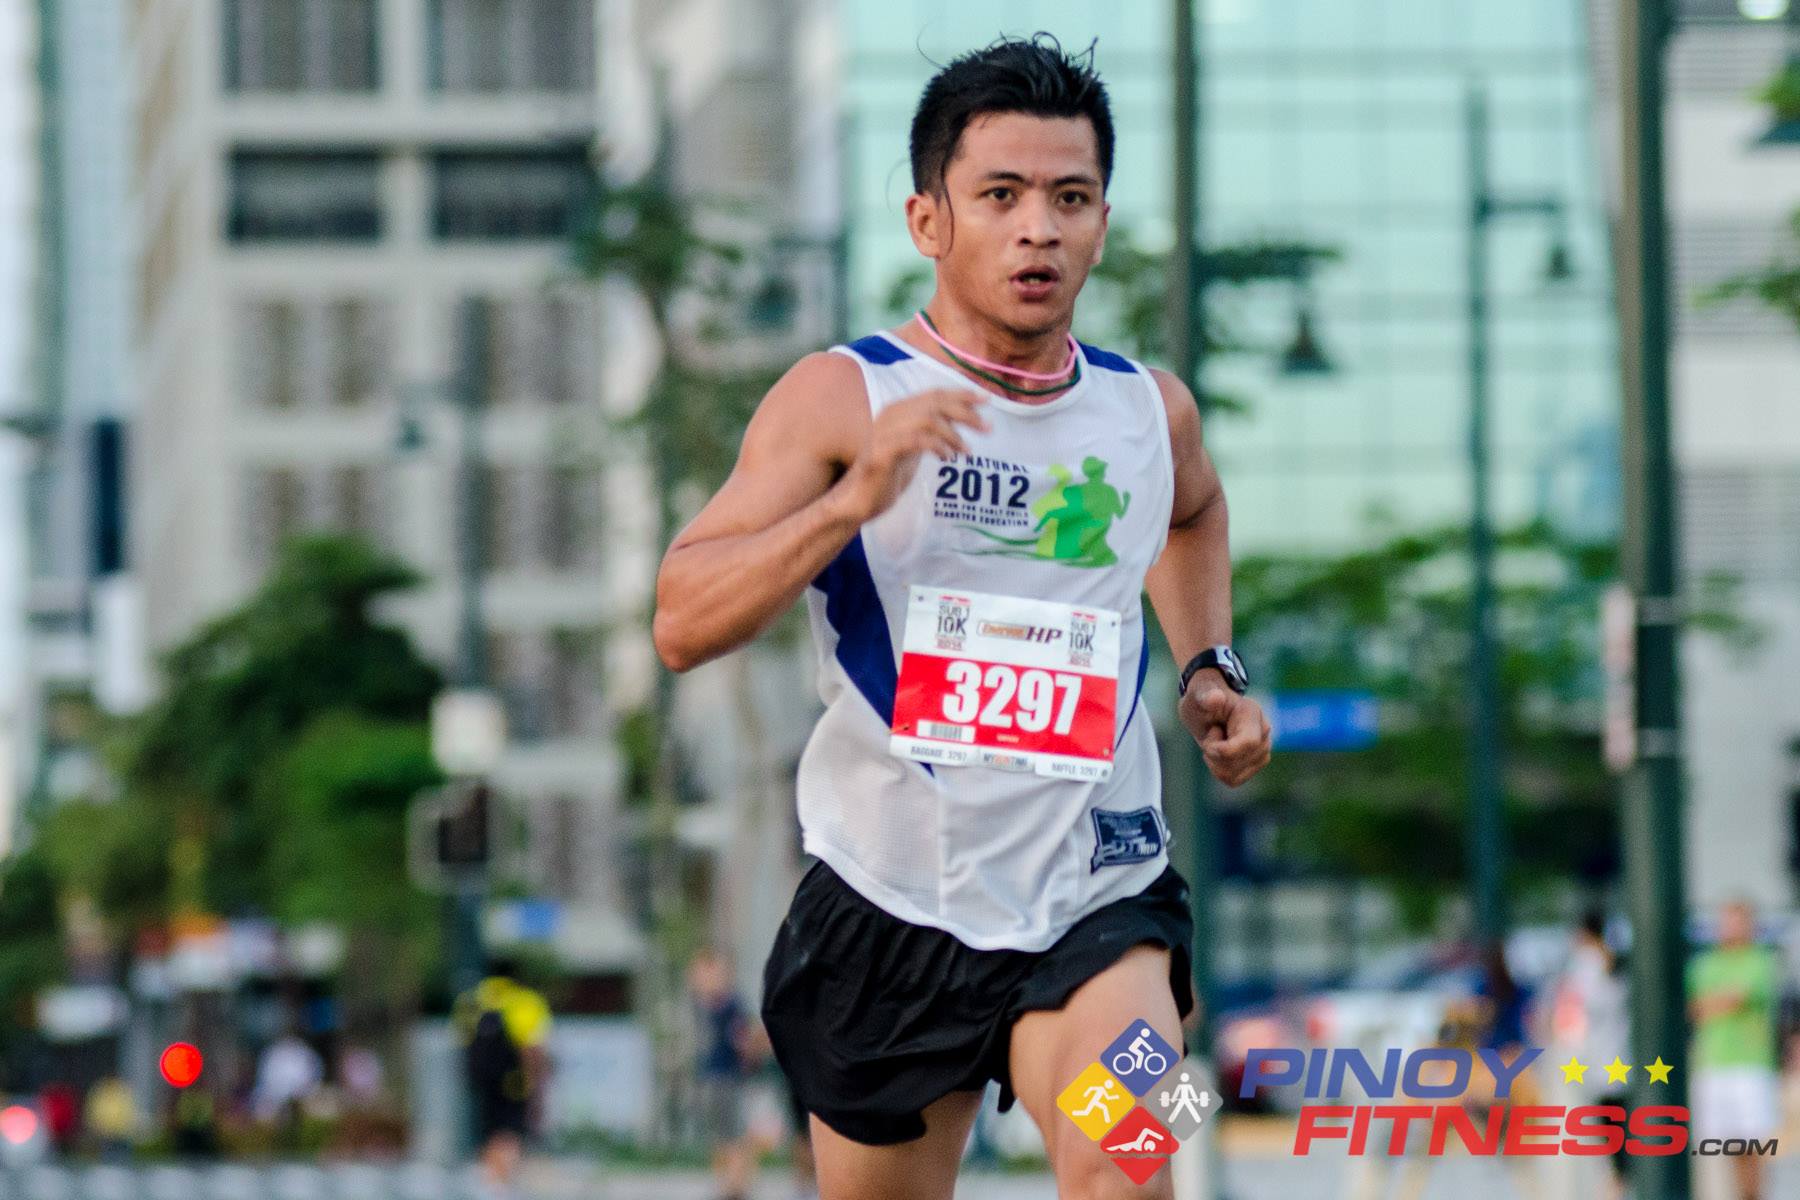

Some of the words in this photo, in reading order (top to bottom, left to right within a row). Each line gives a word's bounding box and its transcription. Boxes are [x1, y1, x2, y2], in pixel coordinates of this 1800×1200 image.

[966, 454, 1029, 473] NATURAL
[936, 465, 1030, 509] 2012
[937, 615, 967, 636] 10K
[1069, 631, 1094, 652] 10K
[942, 660, 1082, 736] 3297
